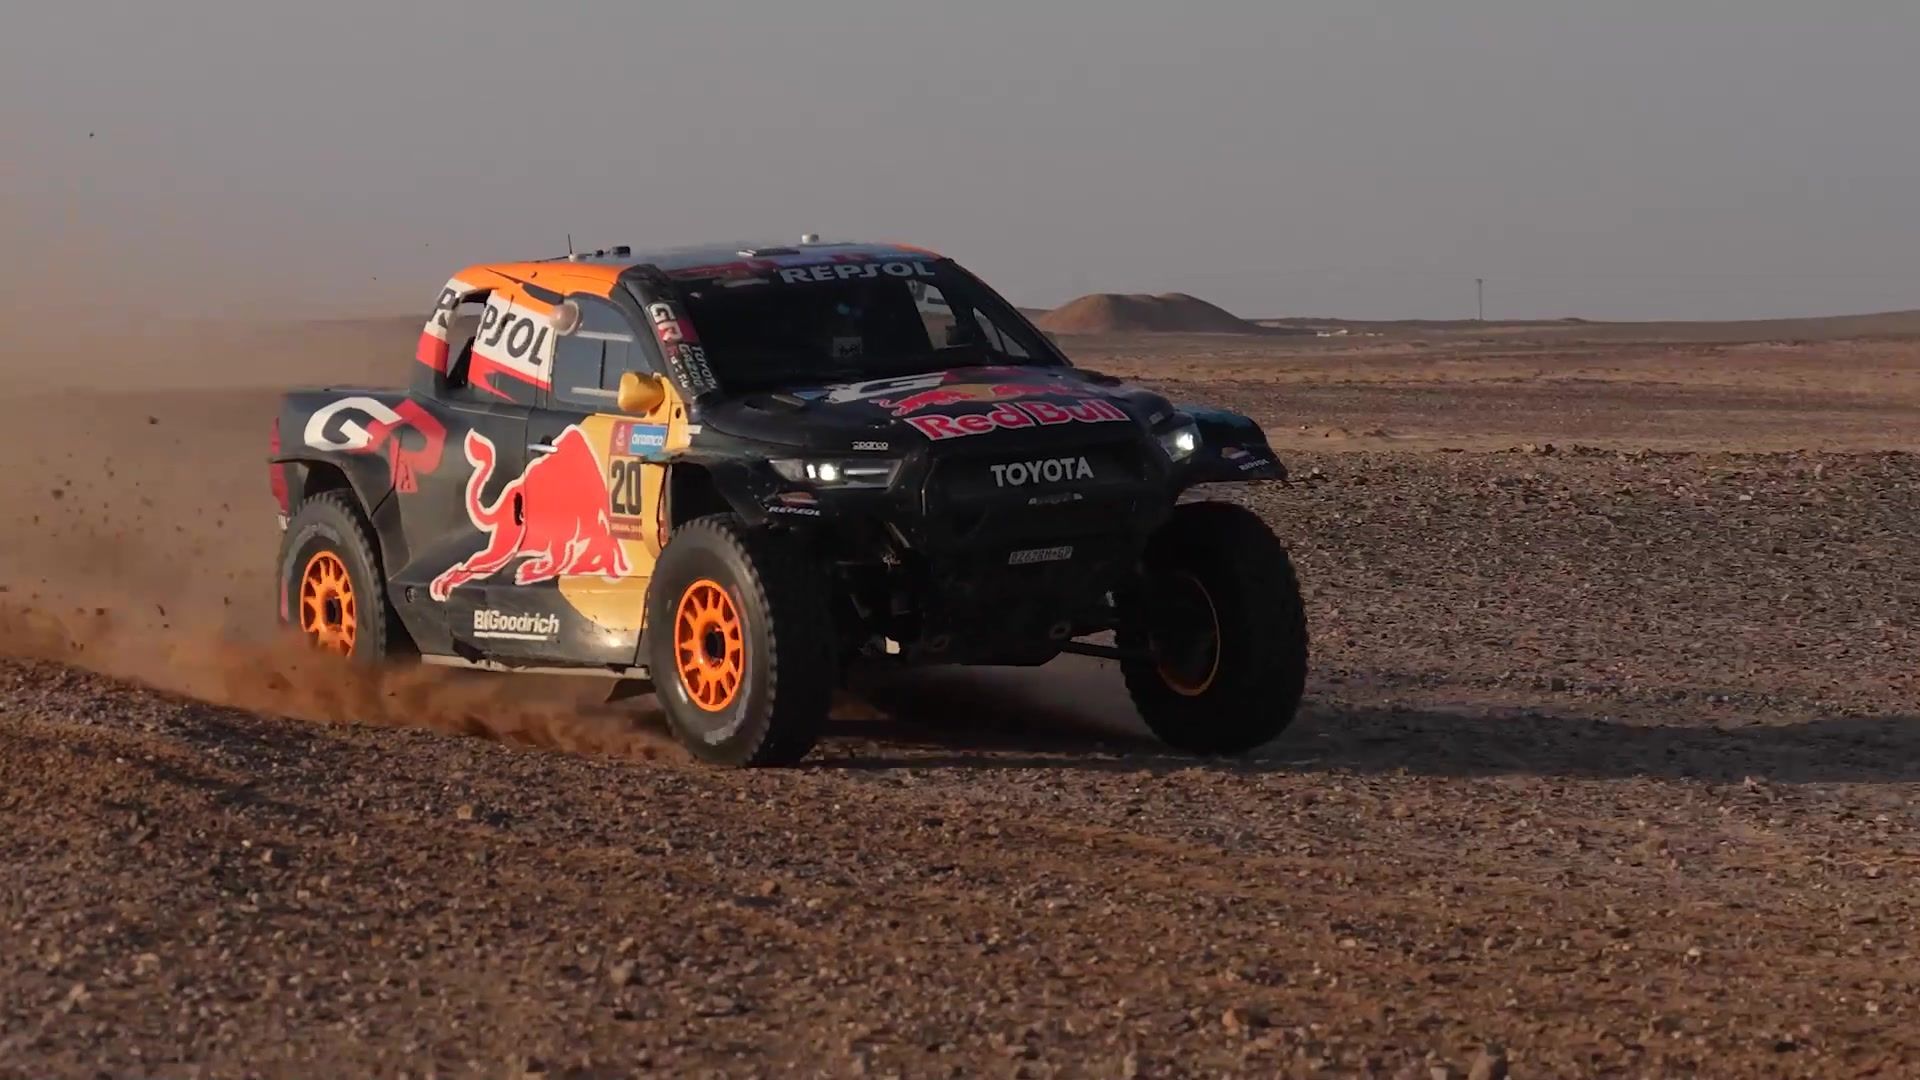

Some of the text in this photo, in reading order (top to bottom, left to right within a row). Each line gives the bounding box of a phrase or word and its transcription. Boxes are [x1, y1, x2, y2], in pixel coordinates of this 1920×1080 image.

[780, 261, 936, 283] REPSOL
[431, 287, 549, 366] RPSOL
[905, 399, 1132, 440] Red Bull
[611, 459, 642, 515] 20
[990, 456, 1095, 488] TOYOTA
[768, 505, 821, 517] REPSOL
